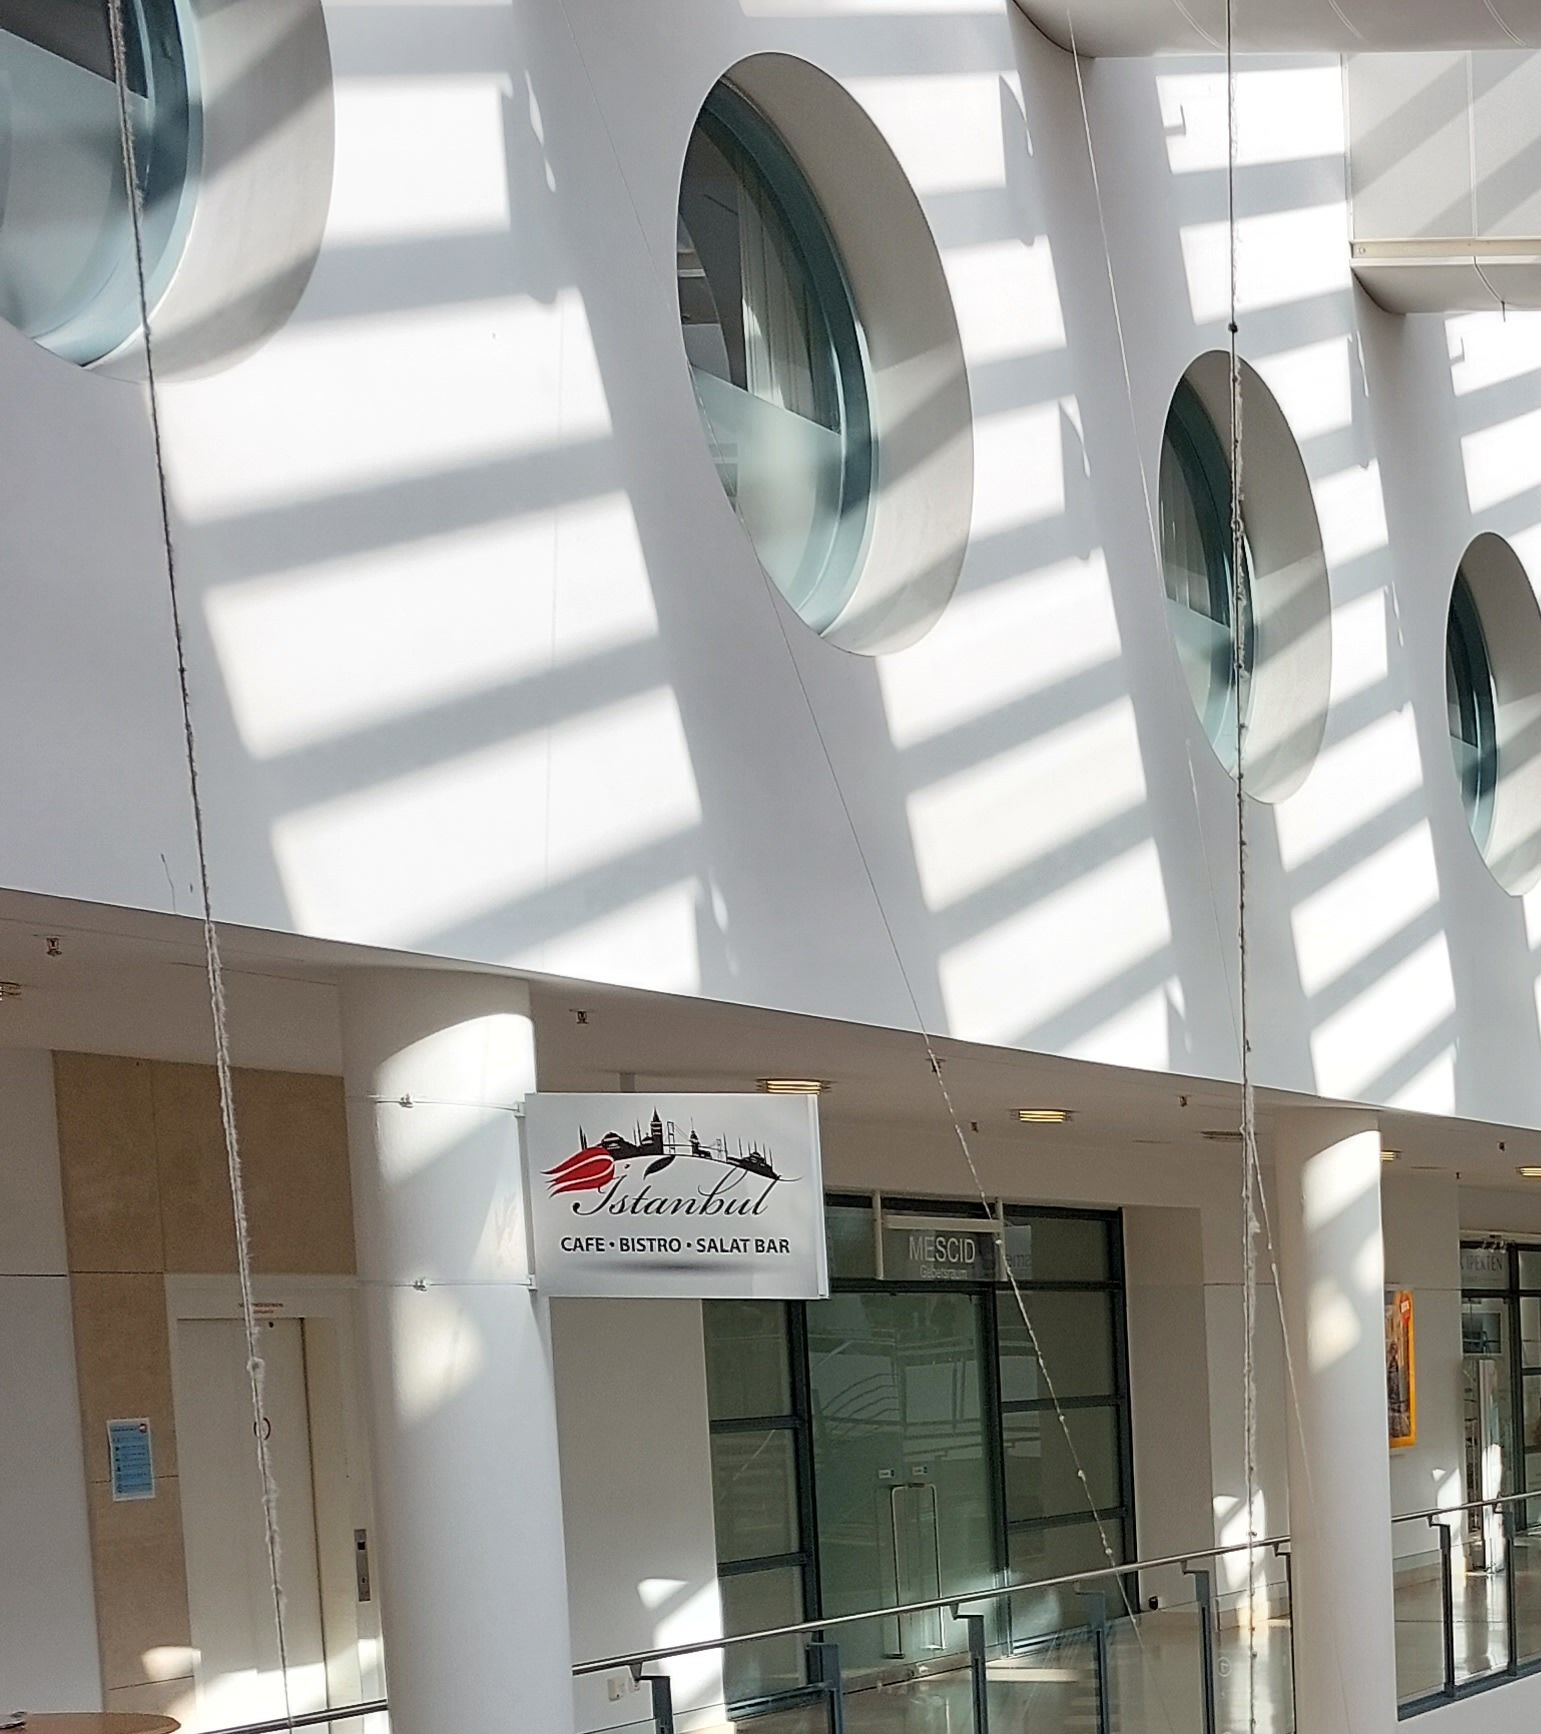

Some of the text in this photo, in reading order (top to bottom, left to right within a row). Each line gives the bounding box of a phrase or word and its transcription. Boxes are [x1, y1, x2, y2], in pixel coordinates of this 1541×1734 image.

[561, 1237, 790, 1254] CAFE BISTRO SALAT BAR
[909, 1236, 976, 1264] MESCID
